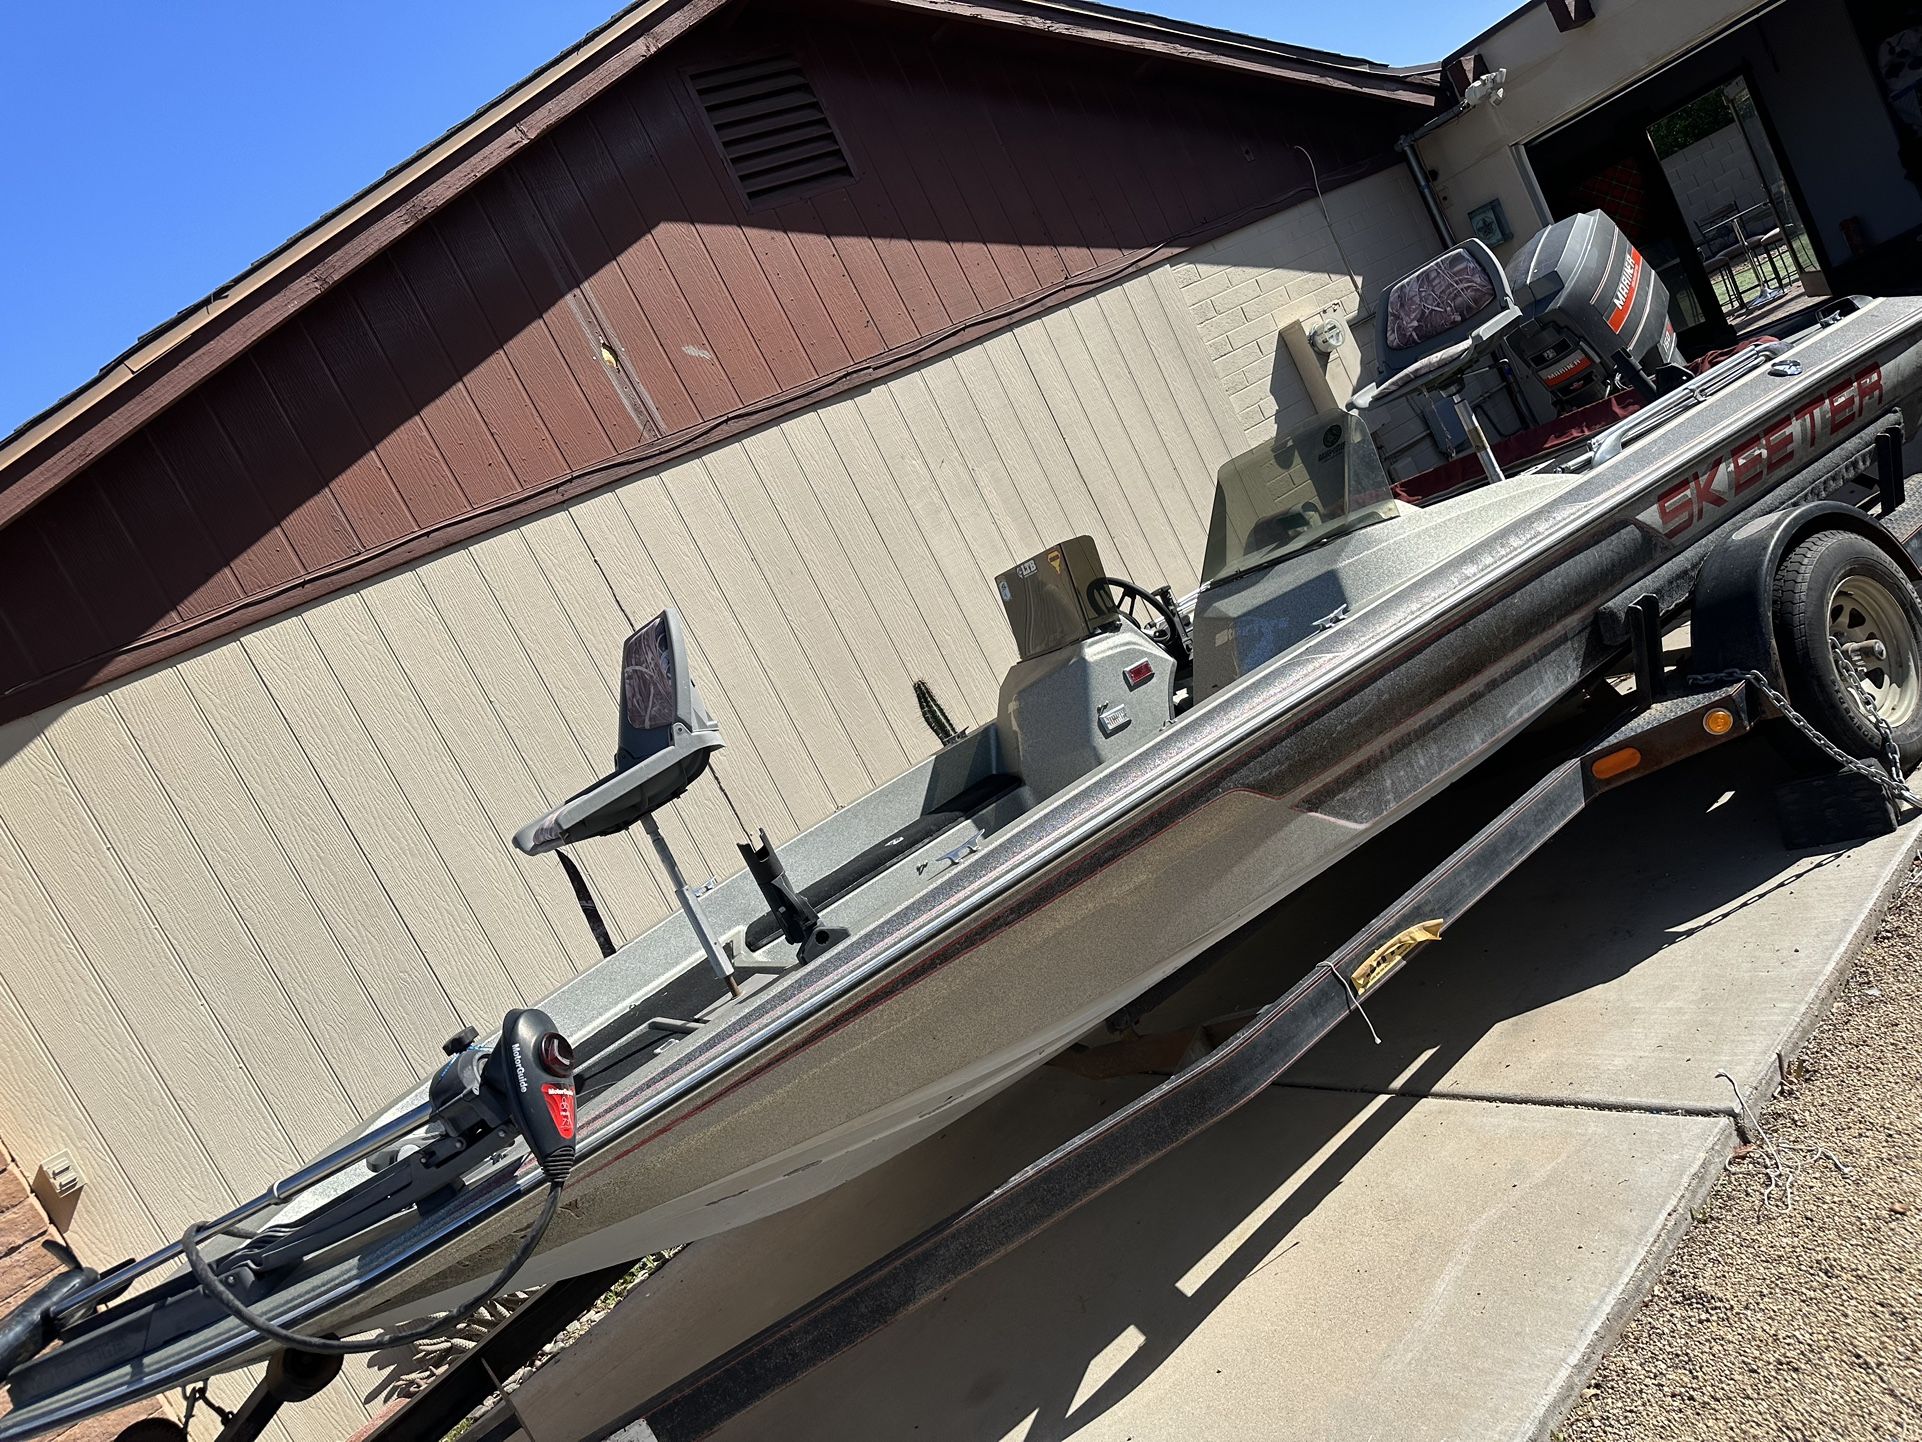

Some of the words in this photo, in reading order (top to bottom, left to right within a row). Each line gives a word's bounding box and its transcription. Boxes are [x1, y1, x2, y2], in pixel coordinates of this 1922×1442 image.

[1613, 253, 1636, 311] MARINER
[1546, 358, 1581, 380] MARINER
[1656, 361, 1883, 540] SKEETER
[512, 1043, 528, 1092] MotorGuide
